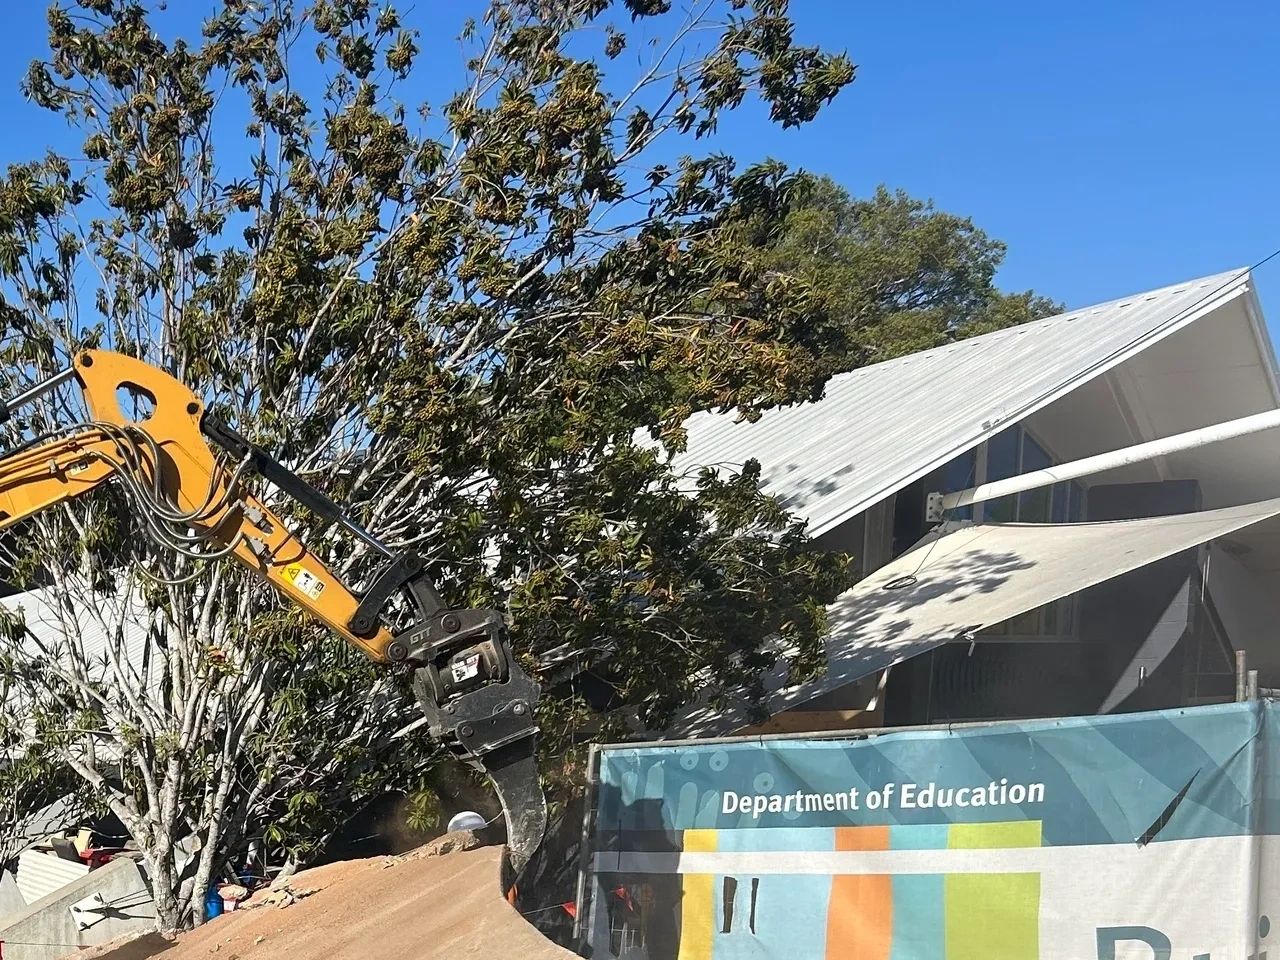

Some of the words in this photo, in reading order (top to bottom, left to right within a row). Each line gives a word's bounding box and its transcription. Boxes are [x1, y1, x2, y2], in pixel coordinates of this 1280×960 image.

[721, 789, 859, 819] Department
[865, 783, 895, 809] of
[900, 778, 1045, 809] Education
